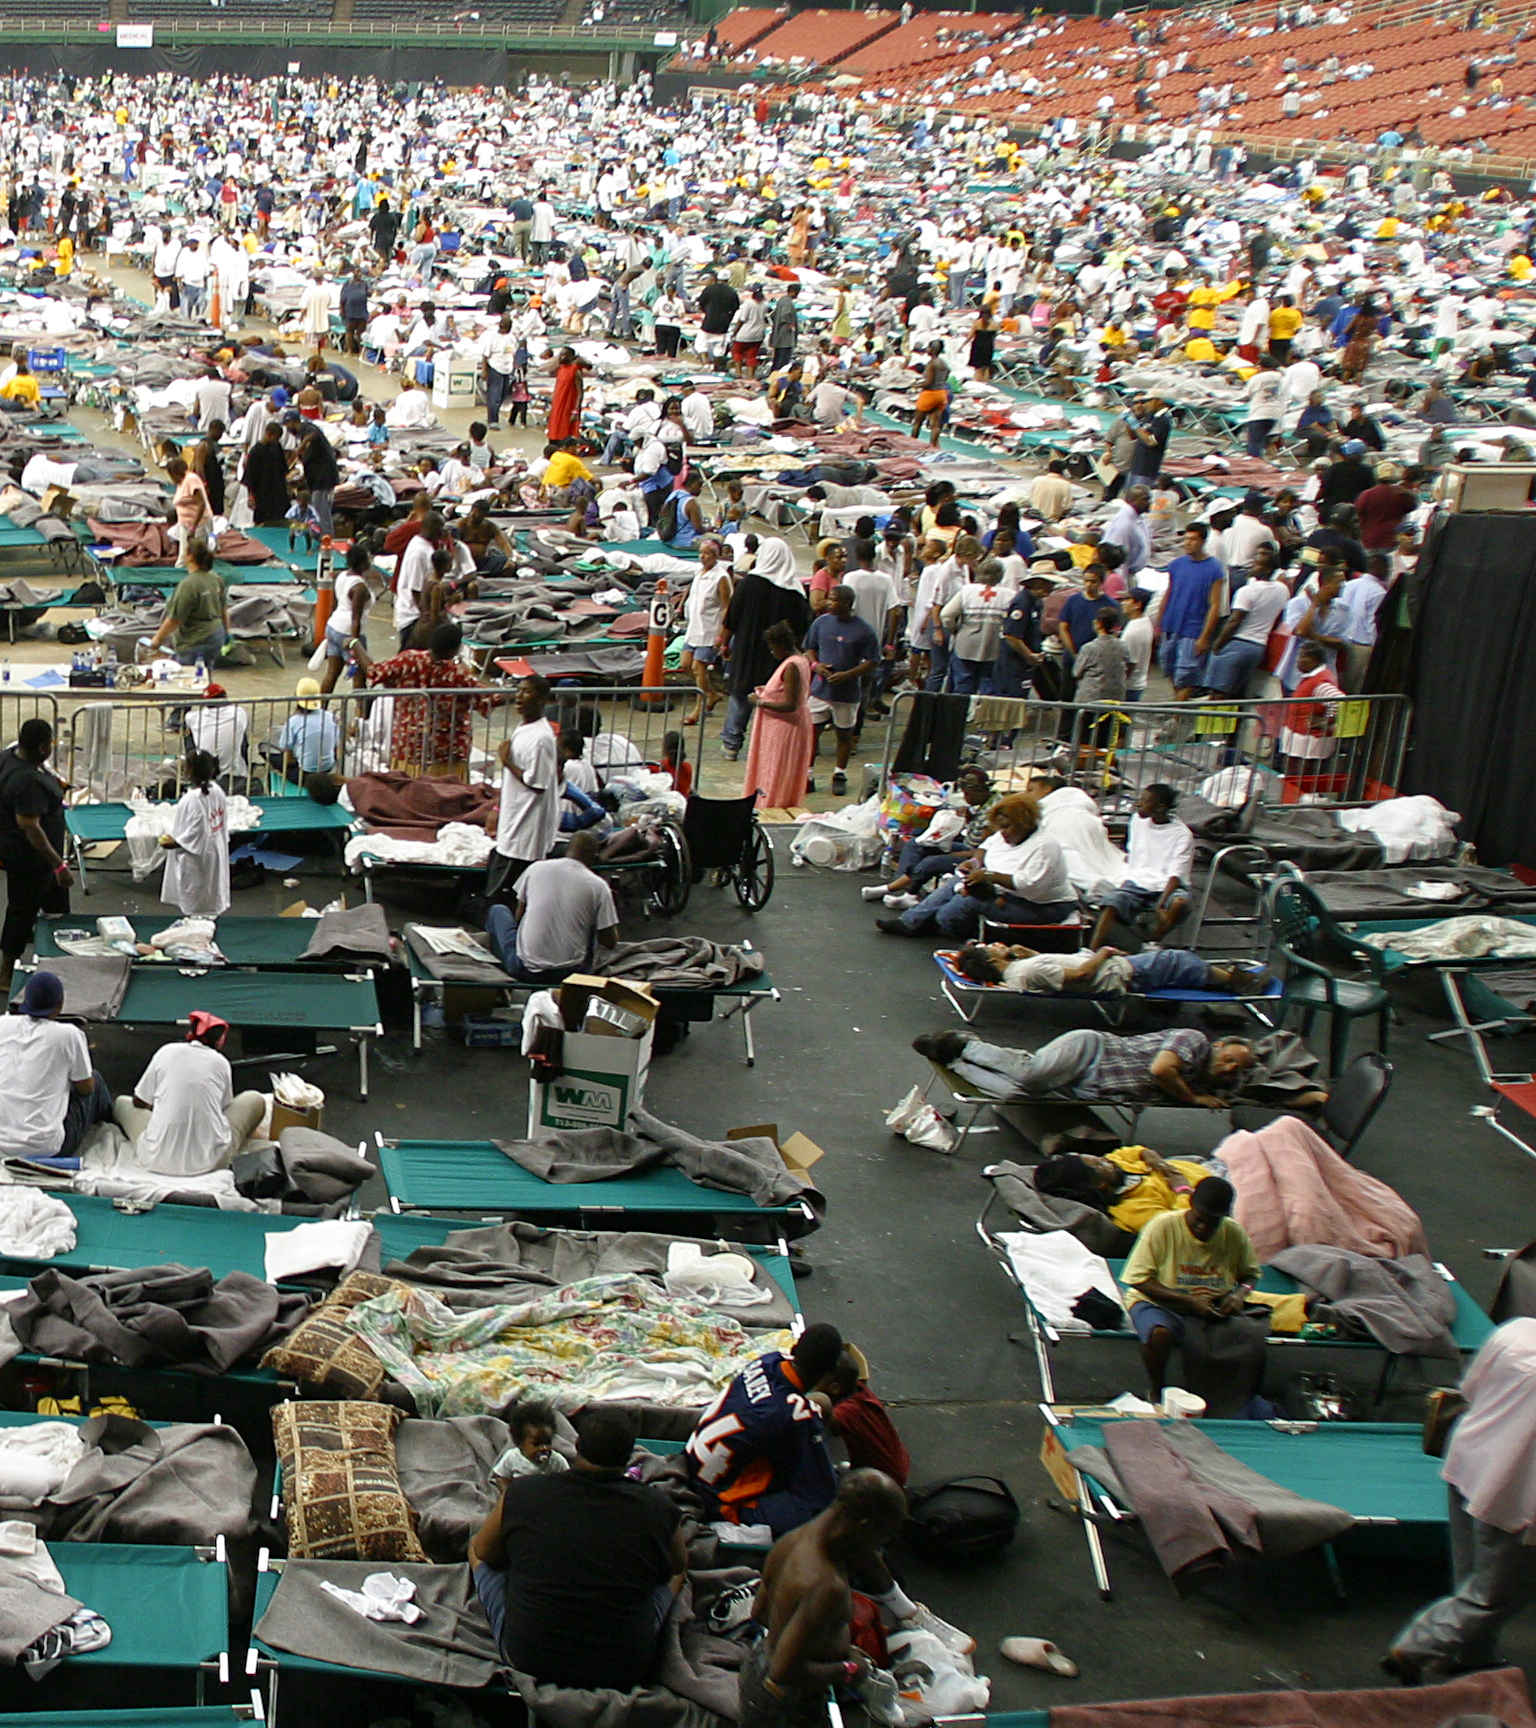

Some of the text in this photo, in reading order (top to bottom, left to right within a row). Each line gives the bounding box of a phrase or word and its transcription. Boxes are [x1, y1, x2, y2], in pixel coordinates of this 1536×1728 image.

[320, 558, 331, 578] F
[654, 603, 667, 625] G
[553, 1085, 613, 1110] WM
